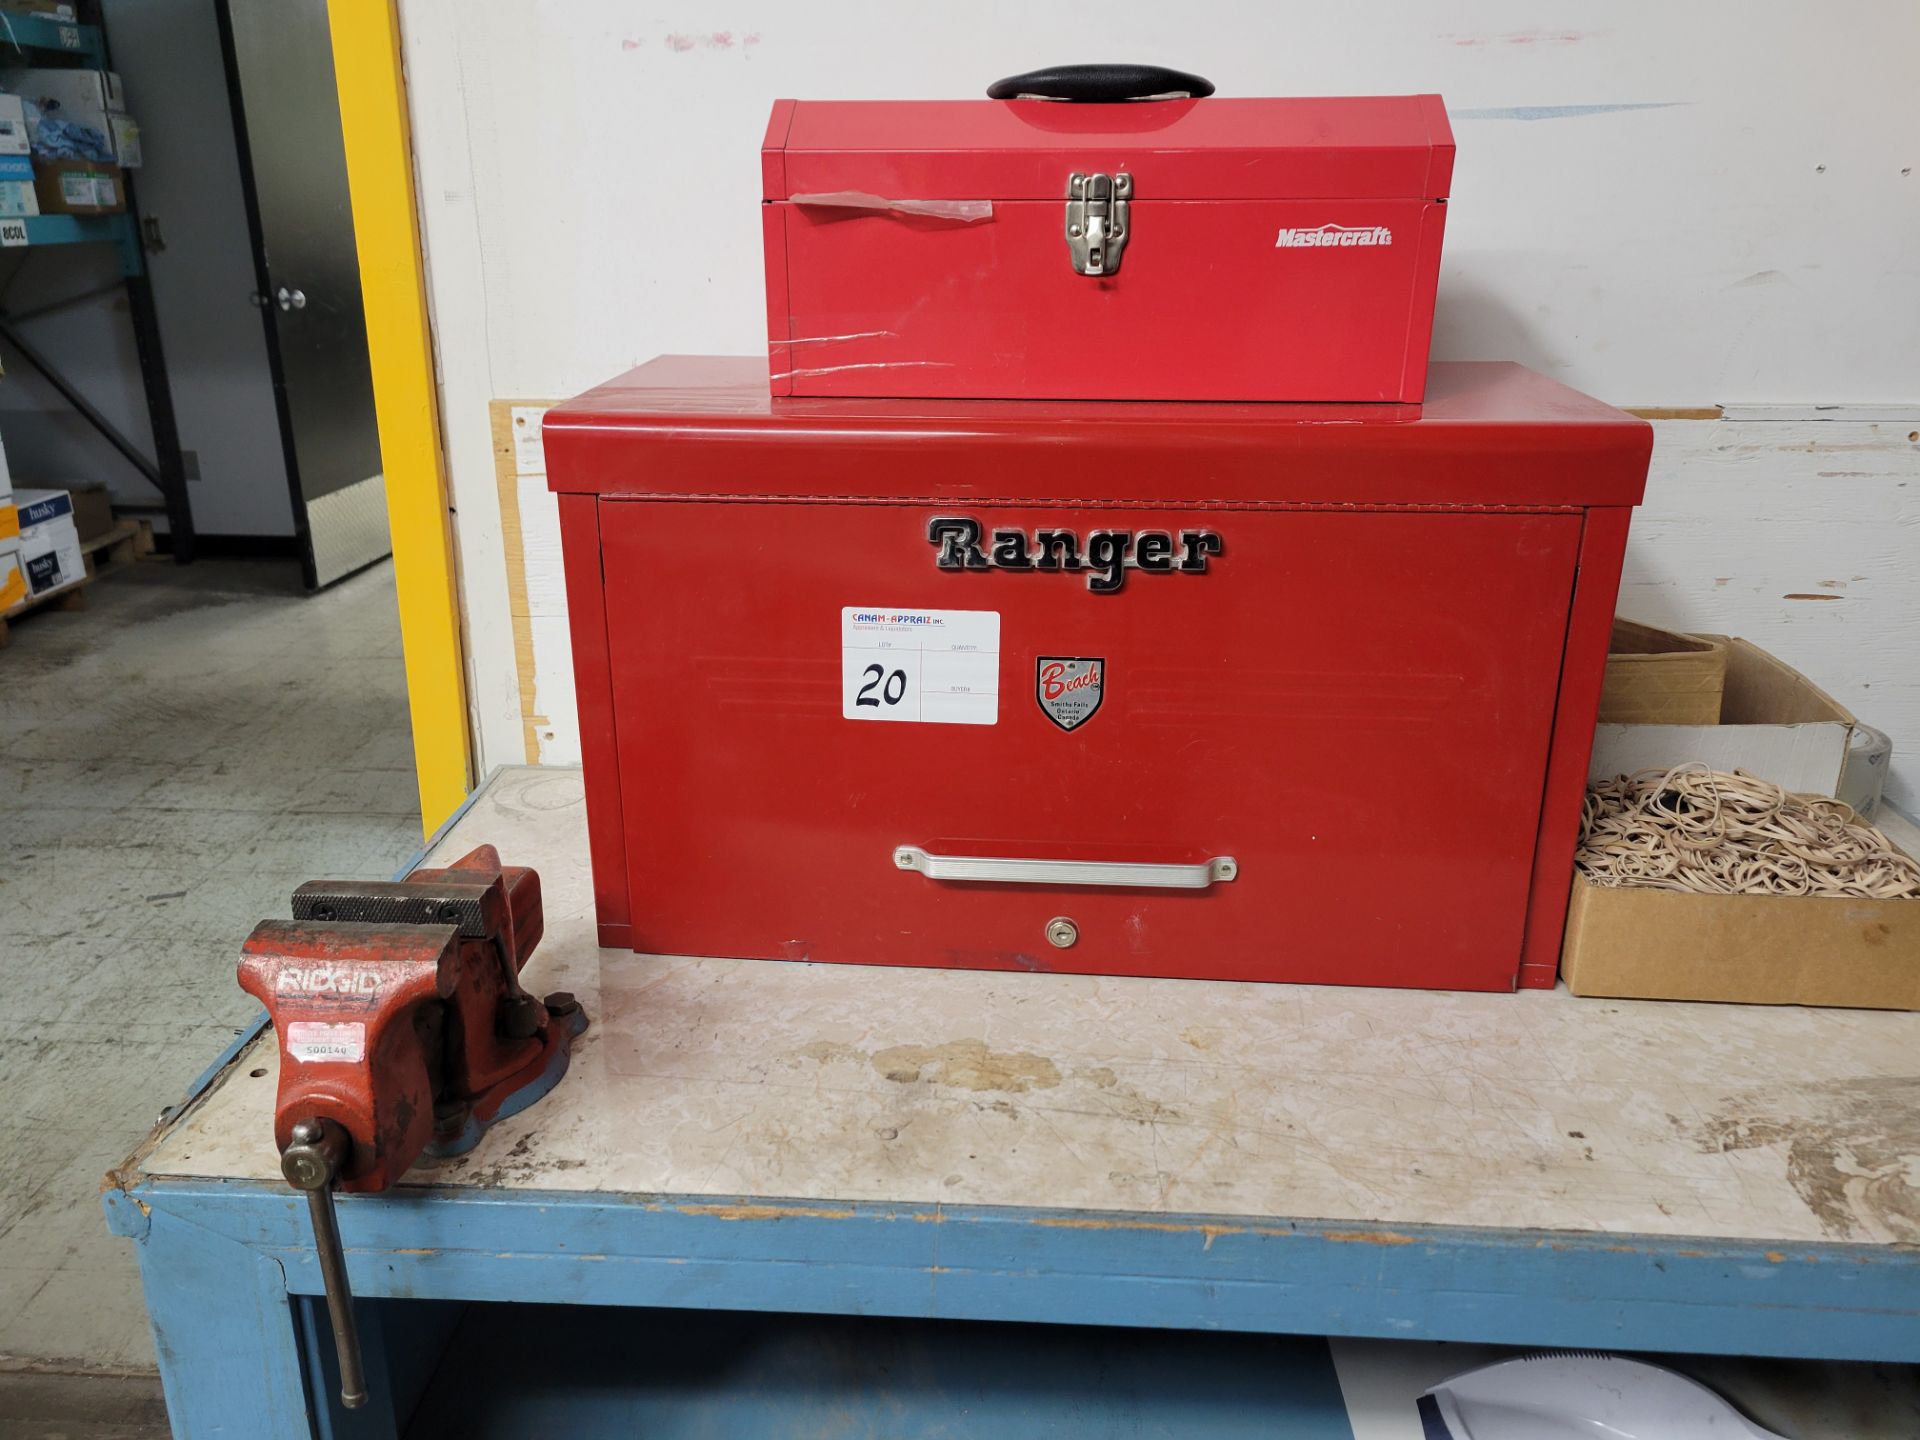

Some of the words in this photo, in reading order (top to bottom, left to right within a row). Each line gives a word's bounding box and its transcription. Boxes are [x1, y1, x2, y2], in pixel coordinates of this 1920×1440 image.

[1275, 226, 1391, 248] Mastercraft
[29, 501, 56, 522] husky
[928, 517, 1221, 591] Ranger
[856, 664, 907, 707] 20
[1041, 662, 1099, 700] Beach
[276, 967, 385, 994] RIDGID
